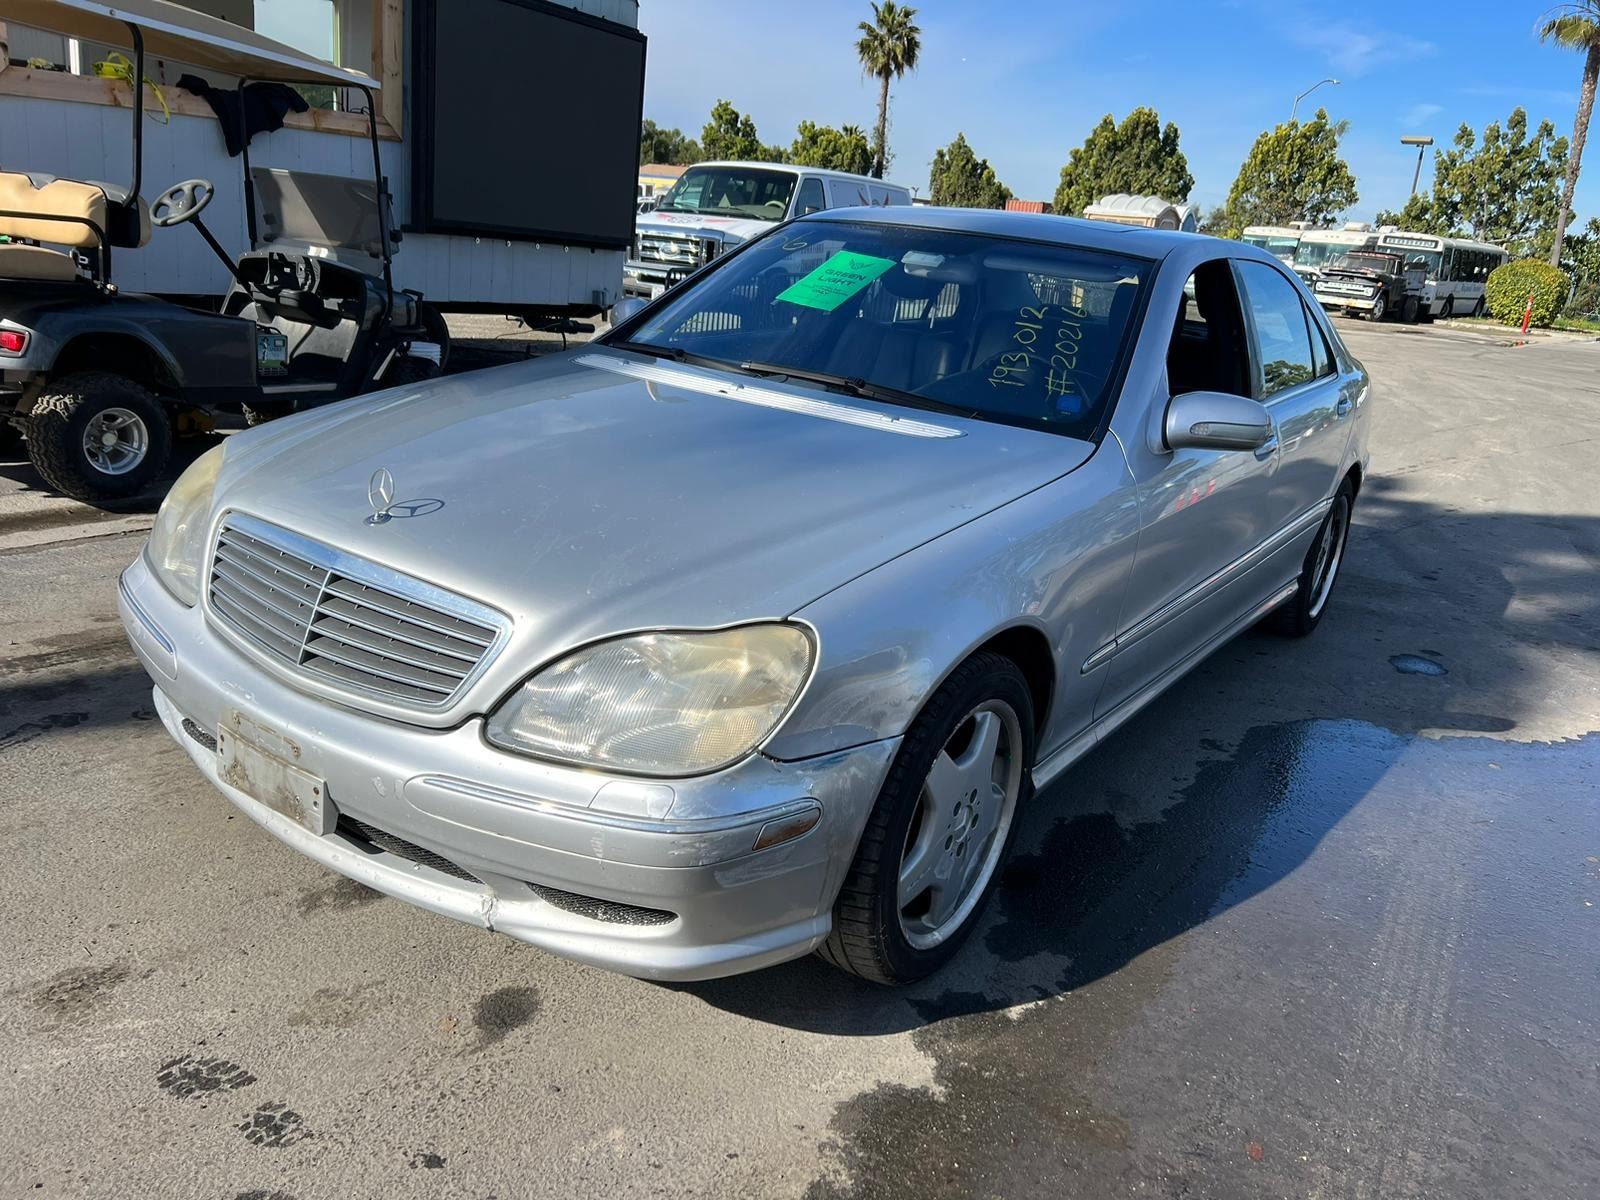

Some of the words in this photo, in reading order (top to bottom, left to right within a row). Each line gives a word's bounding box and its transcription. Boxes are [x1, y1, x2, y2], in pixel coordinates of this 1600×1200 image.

[818, 275, 856, 287] LIGHT
[825, 269, 867, 281] GREEN
[988, 306, 1048, 388] 193,012
[1044, 306, 1088, 396] #20216
